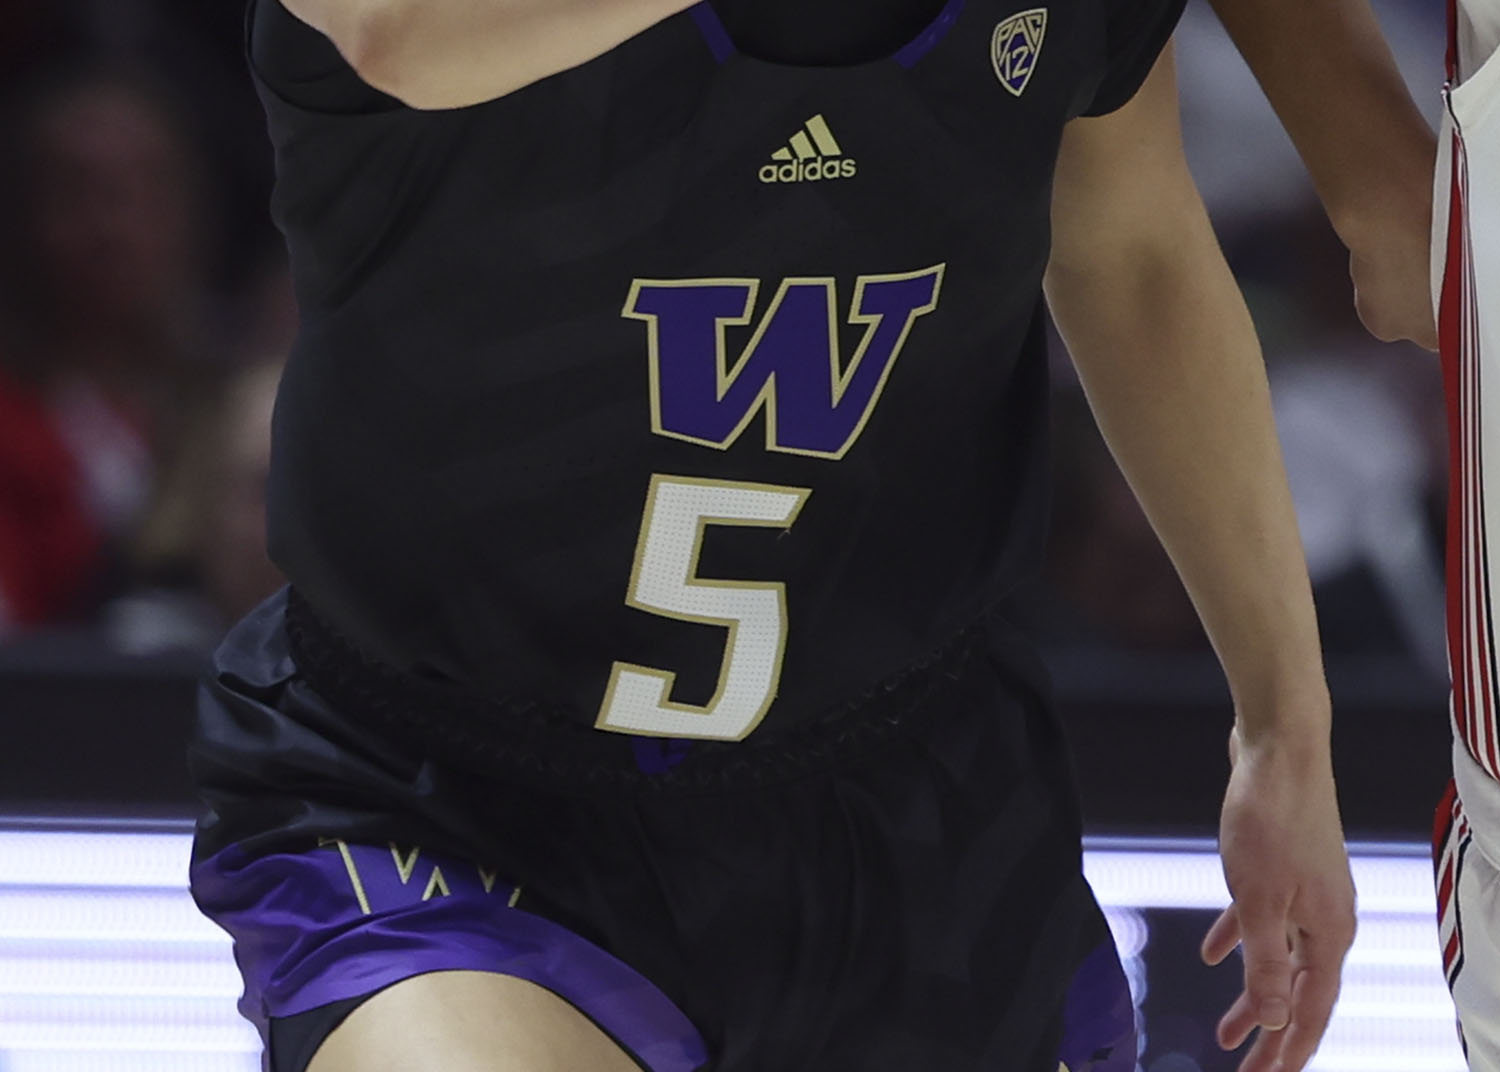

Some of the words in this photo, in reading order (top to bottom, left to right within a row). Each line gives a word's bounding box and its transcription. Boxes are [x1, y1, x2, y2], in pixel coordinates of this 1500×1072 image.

[996, 14, 1042, 67] PAC
[1005, 45, 1029, 81] 12
[758, 155, 857, 183] adidas
[621, 263, 946, 460] W
[594, 473, 812, 741] 5
